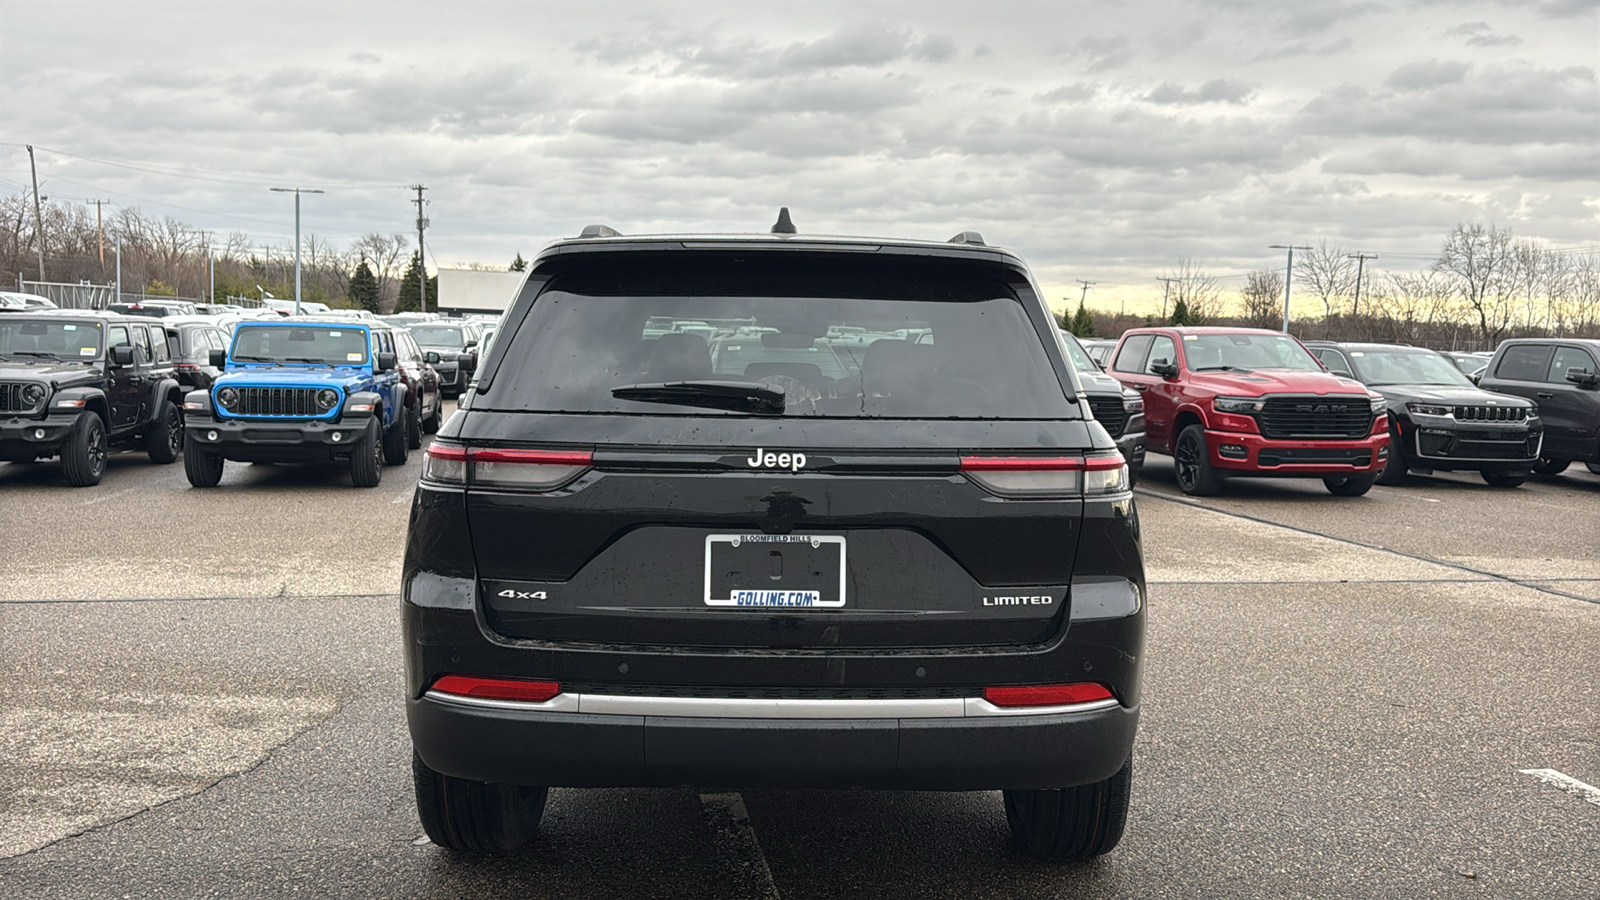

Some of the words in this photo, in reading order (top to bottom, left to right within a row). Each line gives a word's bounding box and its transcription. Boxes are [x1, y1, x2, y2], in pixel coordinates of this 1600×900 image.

[1296, 404, 1347, 413] RAM
[747, 448, 806, 471] Jeep
[740, 535, 788, 543] BLOOMFIELD
[497, 589, 548, 600] 4x4
[737, 591, 813, 606] GOLLING.COM
[983, 595, 1053, 606] LIMITED
